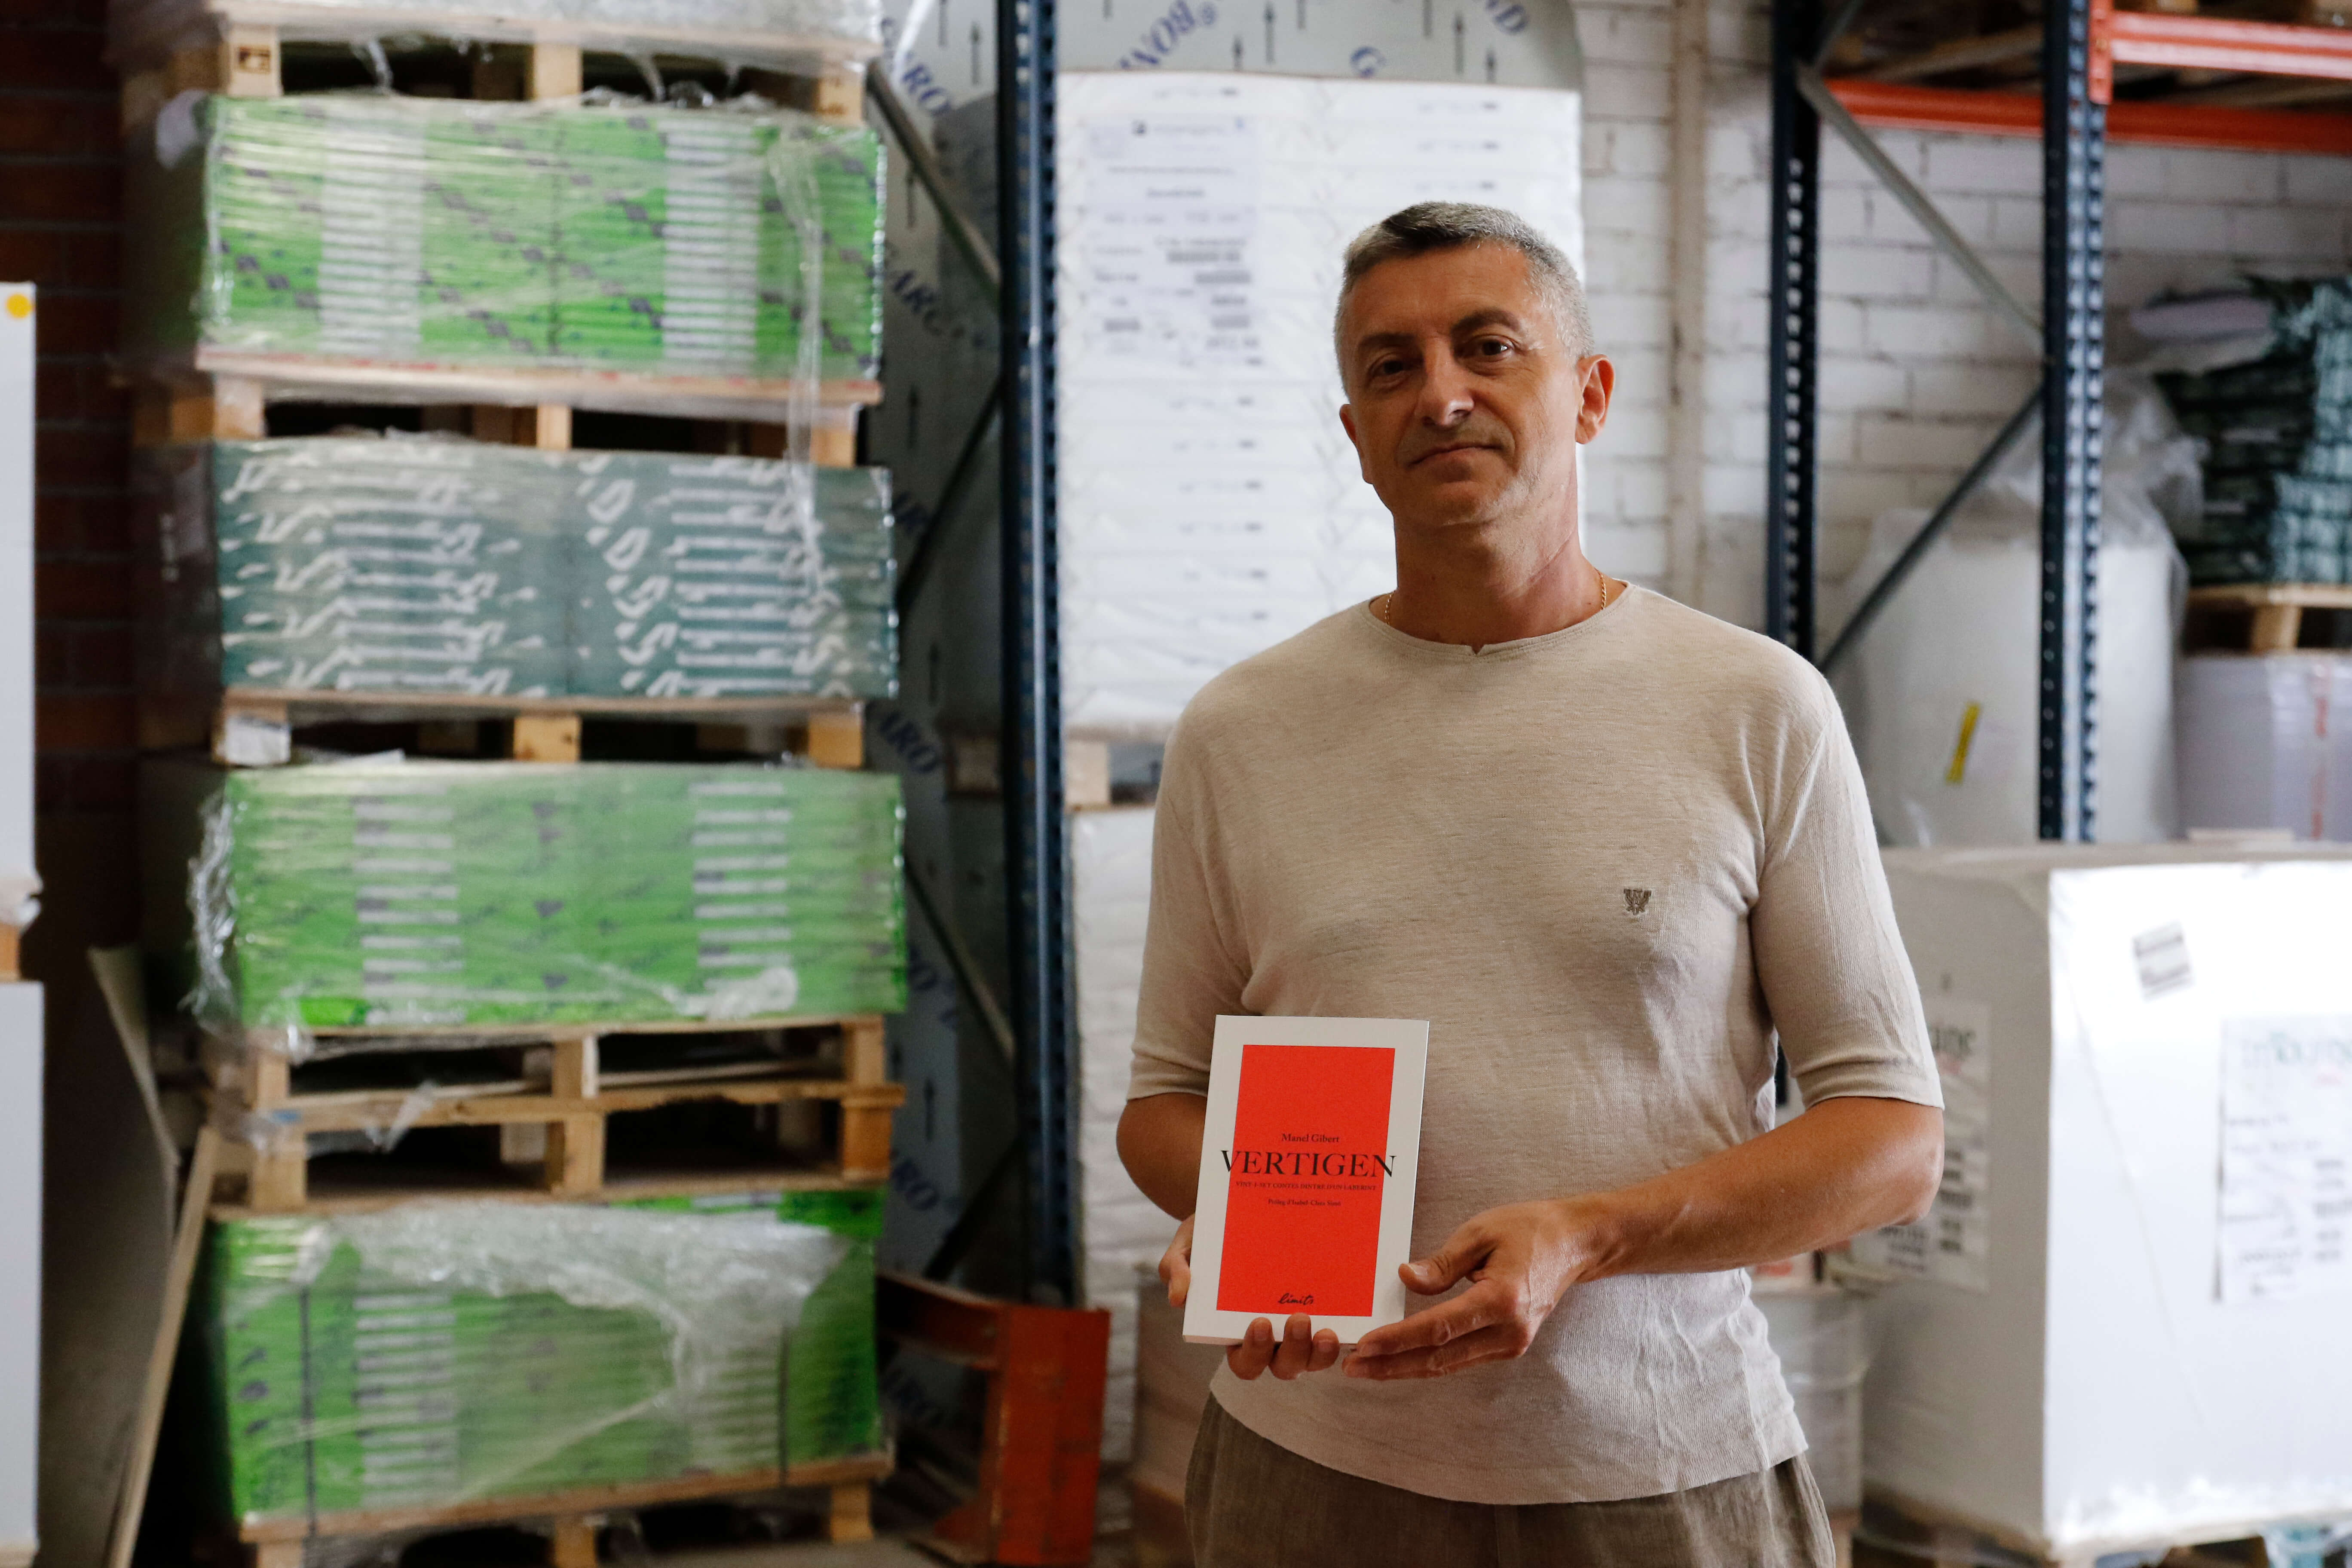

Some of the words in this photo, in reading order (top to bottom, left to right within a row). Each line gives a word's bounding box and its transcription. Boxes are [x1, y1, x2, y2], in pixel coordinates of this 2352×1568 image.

[1282, 1133, 1309, 1142] Manel
[1311, 1133, 1340, 1143] Gibert
[1220, 1150, 1396, 1178] VERTIGEN
